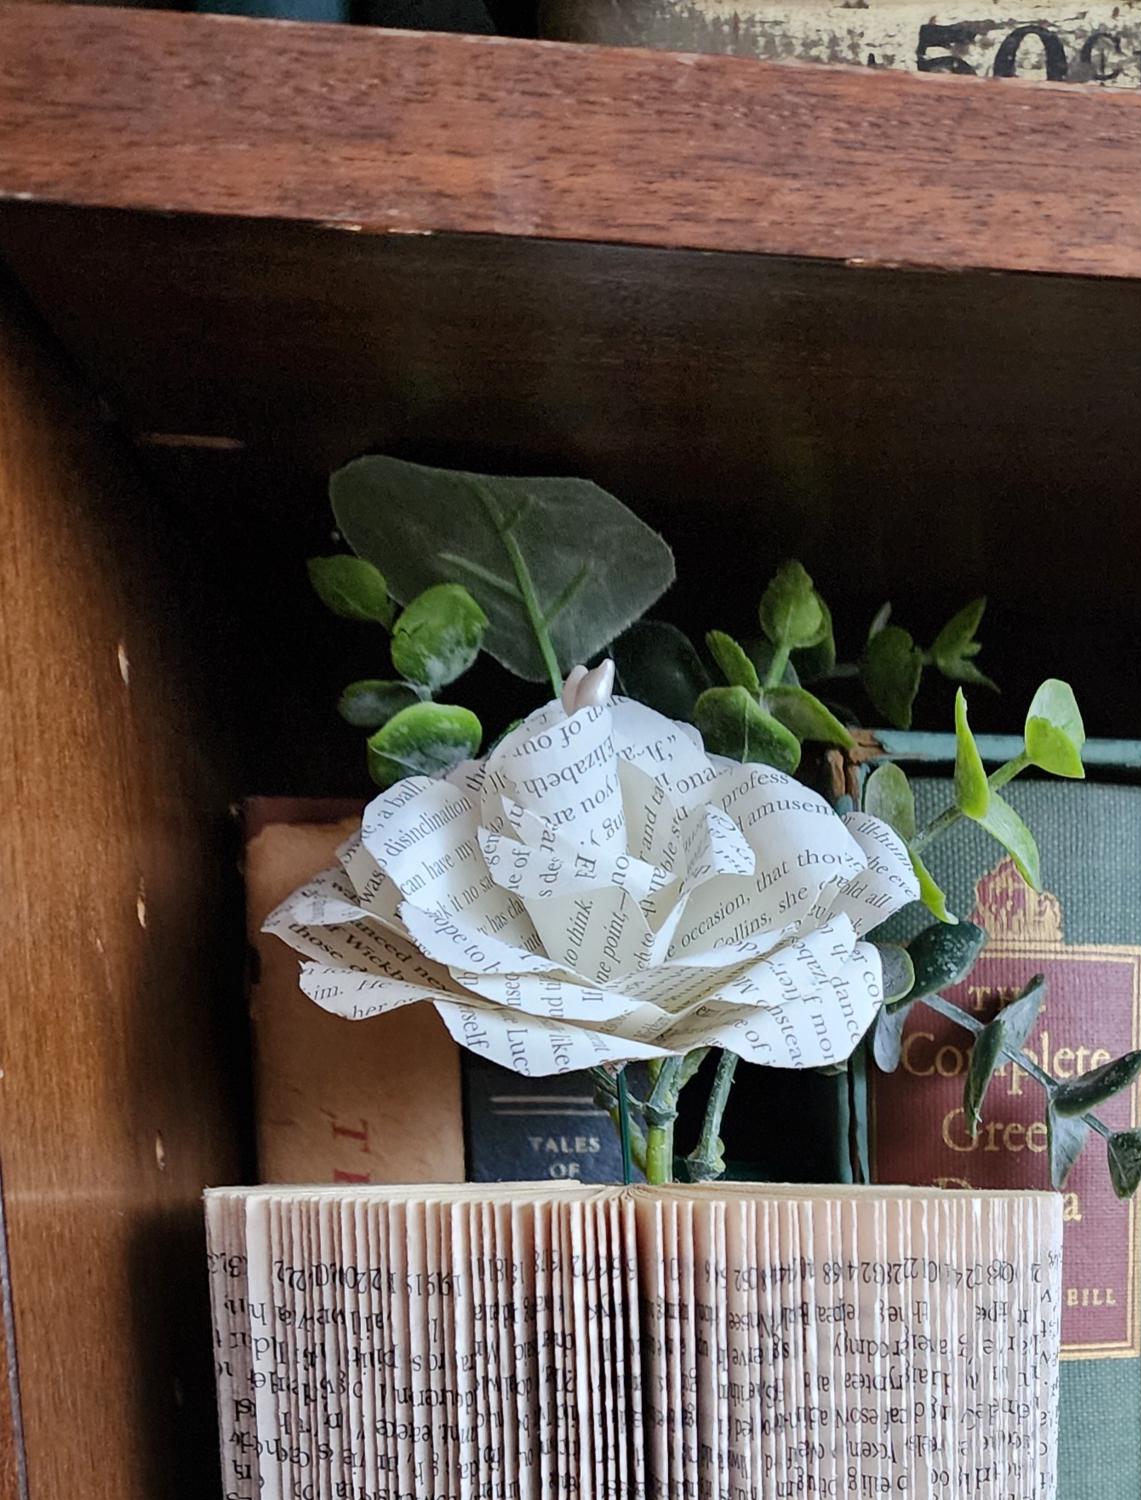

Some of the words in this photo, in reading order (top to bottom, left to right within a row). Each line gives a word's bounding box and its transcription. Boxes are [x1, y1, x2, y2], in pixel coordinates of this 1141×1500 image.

[523, 736, 614, 799] Elizabeth
[383, 795, 474, 858] disinclination
[421, 855, 455, 881] have
[755, 861, 790, 893] that
[680, 892, 752, 946] occasion,
[777, 885, 809, 915] she
[287, 922, 345, 961] those
[565, 897, 595, 948] think.
[901, 1030, 1112, 1096] Coplete
[528, 1135, 601, 1155] TALES
[941, 1107, 1050, 1153] Gree
[549, 1162, 581, 1179] OF
